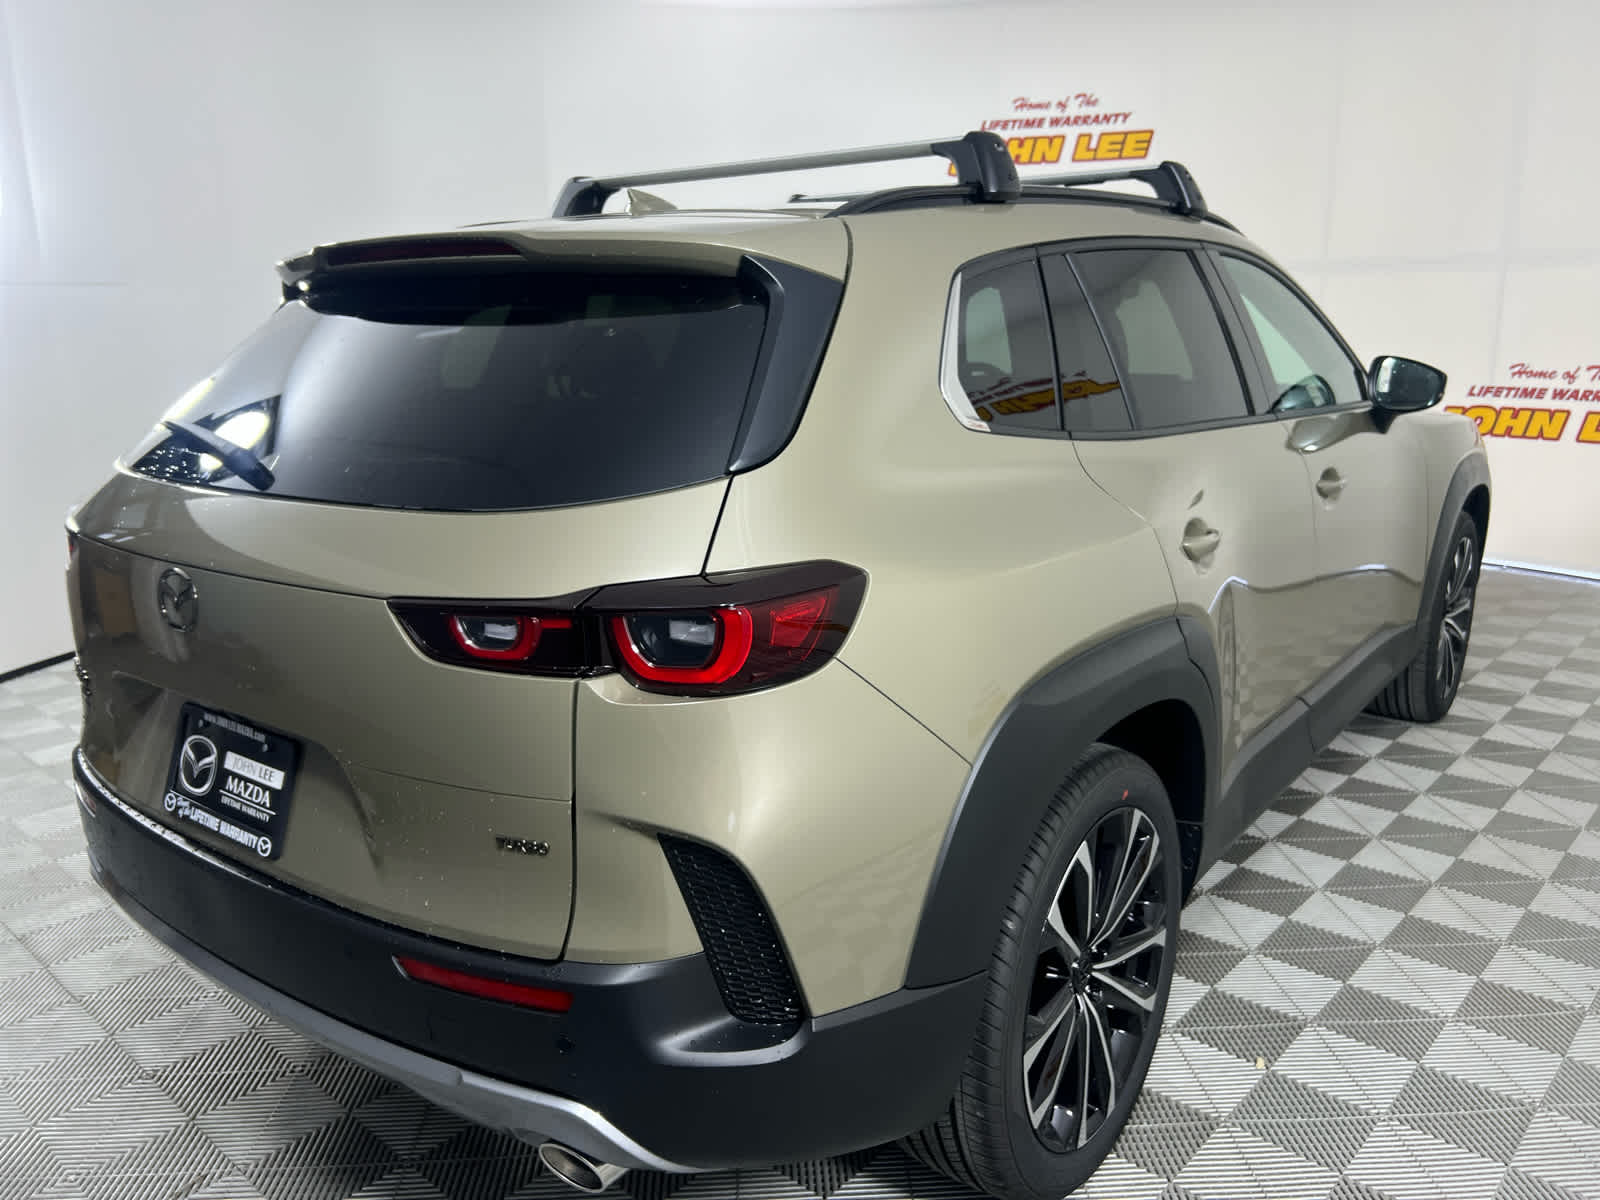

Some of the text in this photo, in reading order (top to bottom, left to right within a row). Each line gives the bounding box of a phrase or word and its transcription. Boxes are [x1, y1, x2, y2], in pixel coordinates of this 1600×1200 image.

[1012, 92, 1099, 112] Home of The
[980, 112, 1132, 132] LIFETIME WARRANTY
[1072, 129, 1154, 163] LEE
[1509, 362, 1600, 384] Home of T
[1466, 385, 1548, 399] LIFETIME
[1444, 405, 1571, 441] OHN
[231, 756, 275, 782] JOHN LEE
[225, 775, 270, 808] MAZDA
